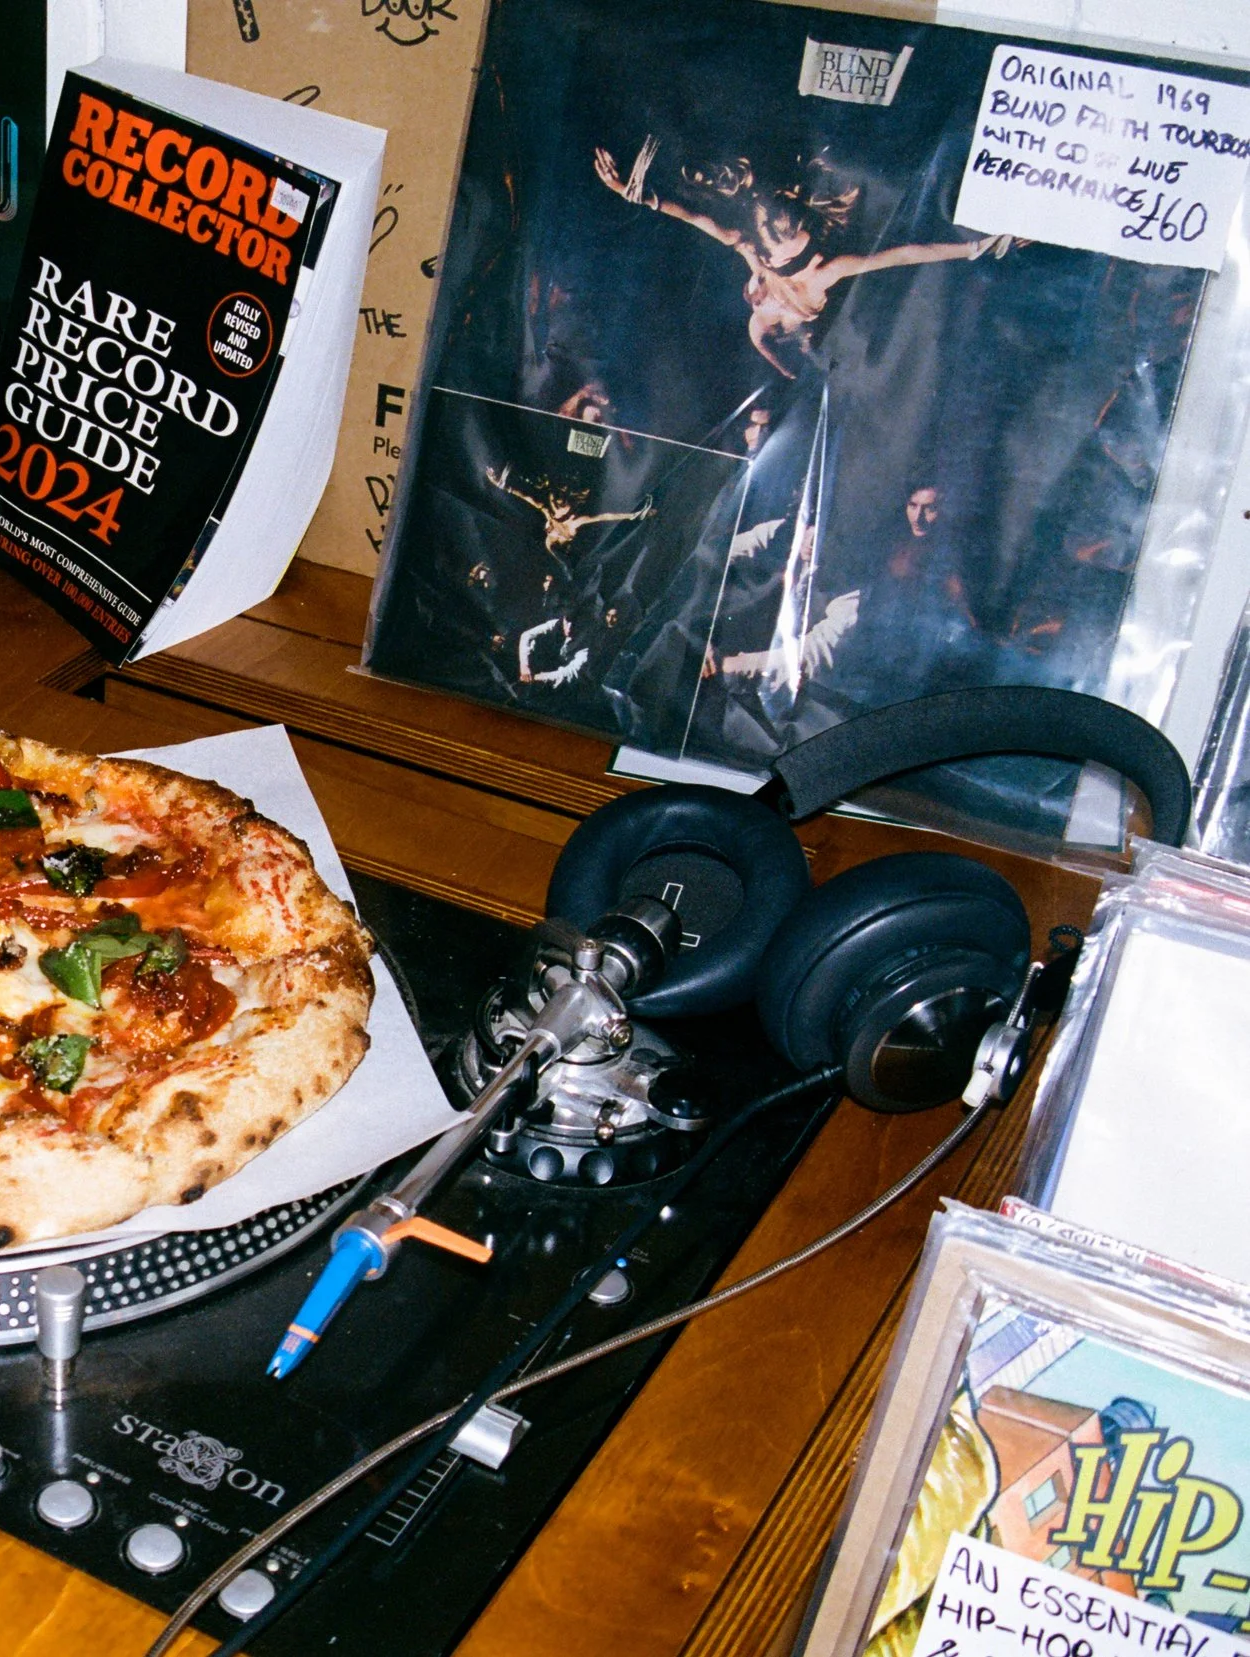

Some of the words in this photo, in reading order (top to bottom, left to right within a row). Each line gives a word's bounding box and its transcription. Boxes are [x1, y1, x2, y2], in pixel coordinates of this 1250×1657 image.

[818, 70, 889, 97] FAITH
[822, 50, 892, 78] BLIND
[1000, 55, 1134, 99] ORIGINAL
[1157, 83, 1211, 115] 1969
[990, 90, 1066, 127] BLIND
[1076, 104, 1149, 141] FAITH
[973, 148, 1147, 213] PERFORMANCE
[982, 124, 1046, 153] WITH
[1055, 141, 1088, 164] CD
[1128, 156, 1188, 184] LIVE
[62, 149, 292, 286] COLLECTOR
[1121, 191, 1208, 242] £60
[31, 256, 177, 358] RARE
[223, 312, 261, 340] REVISED
[233, 299, 261, 323] FULLY
[359, 308, 407, 338] THE
[21, 297, 239, 437] RECORD
[213, 340, 253, 370] UPDATED
[227, 331, 248, 350] AND
[11, 337, 164, 448] PRICE
[5, 382, 161, 495] GUIDE
[29, 536, 58, 560] MOST
[56, 552, 118, 607] COMPREHENSIVE
[116, 600, 142, 627] GUIDE
[32, 558, 61, 586] OVER
[61, 579, 92, 613] 100,000
[91, 604, 133, 645] ENTRIES
[949, 1546, 999, 1594] AN
